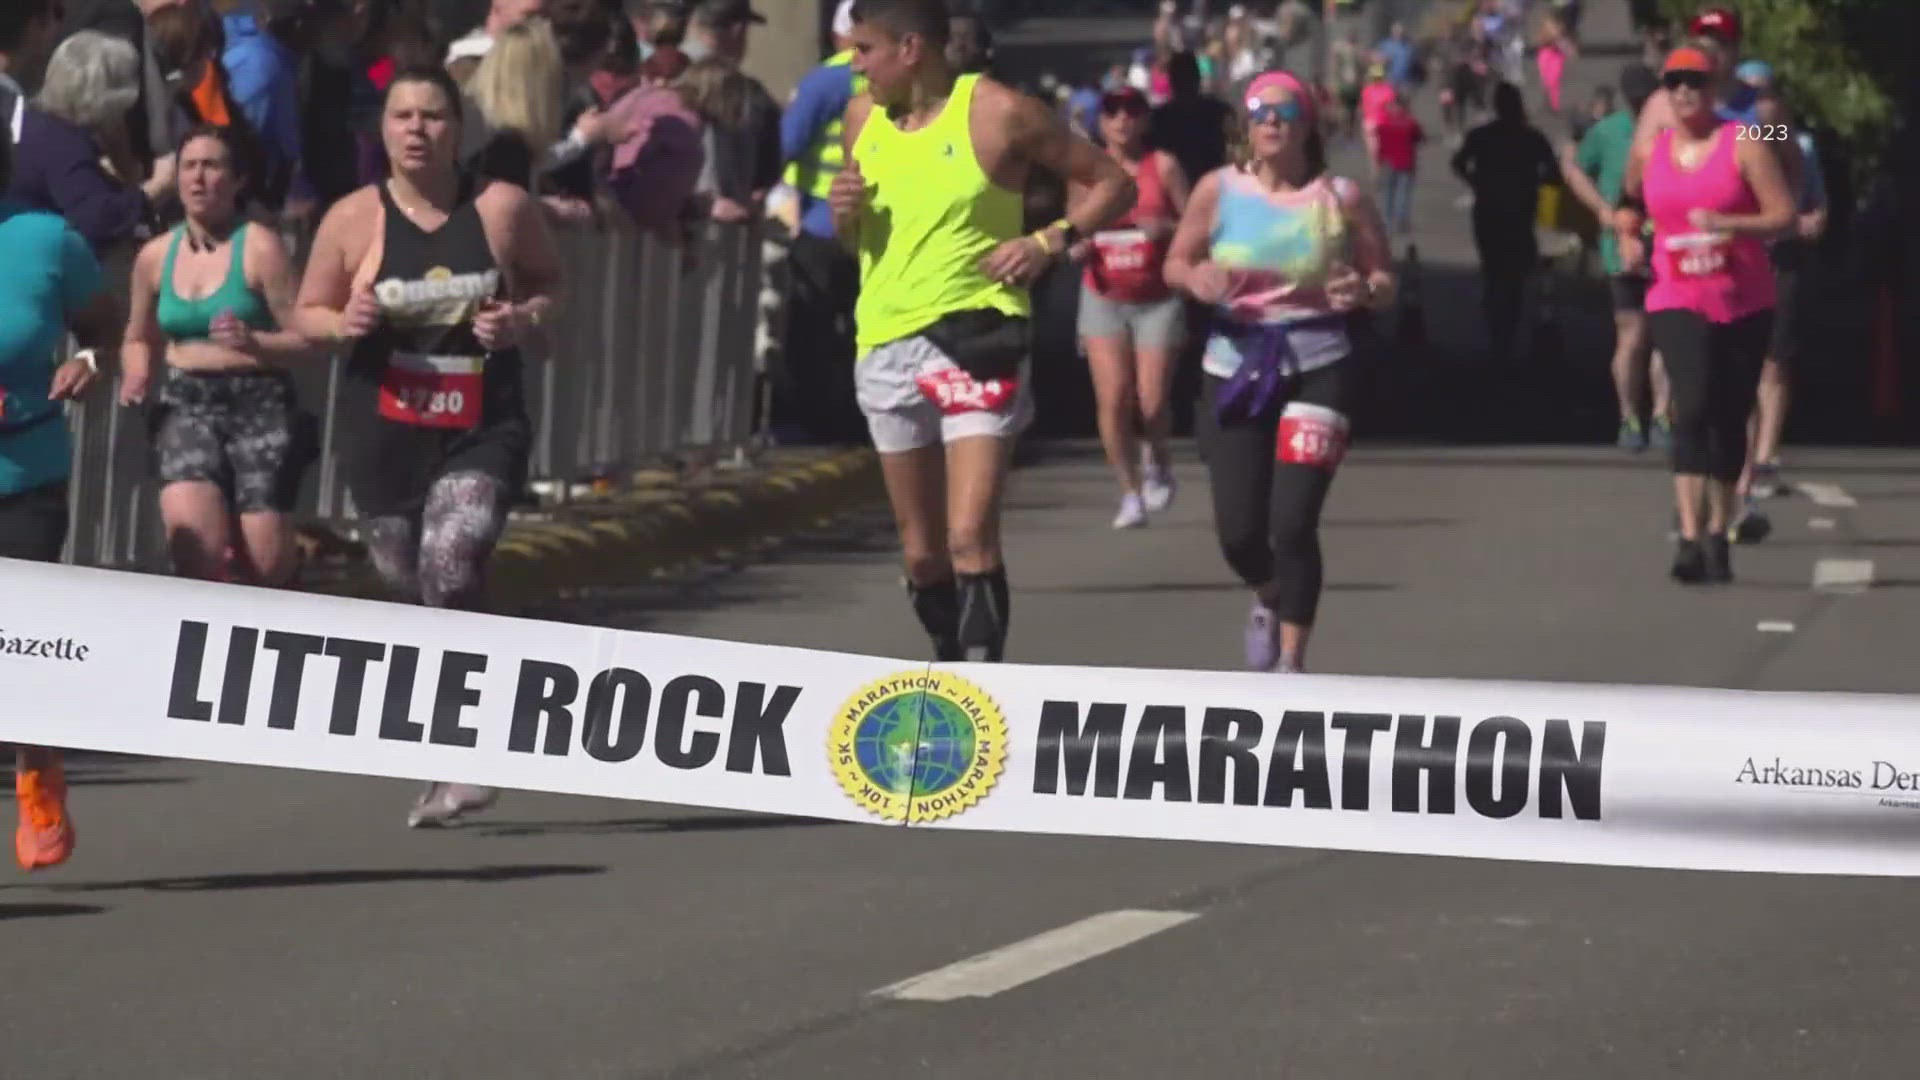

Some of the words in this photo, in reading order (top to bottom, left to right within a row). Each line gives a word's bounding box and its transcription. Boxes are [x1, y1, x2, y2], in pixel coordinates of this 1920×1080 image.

[847, 677, 941, 723] MARATHON
[960, 696, 990, 733] HALF
[167, 620, 489, 748] LITTLE
[507, 659, 803, 777] ROCK
[1032, 700, 1606, 821] MARATHON
[838, 743, 852, 765] 5K
[1735, 756, 1862, 789] Arkansas
[917, 740, 991, 814] MARATHON
[859, 783, 892, 809] 10K
